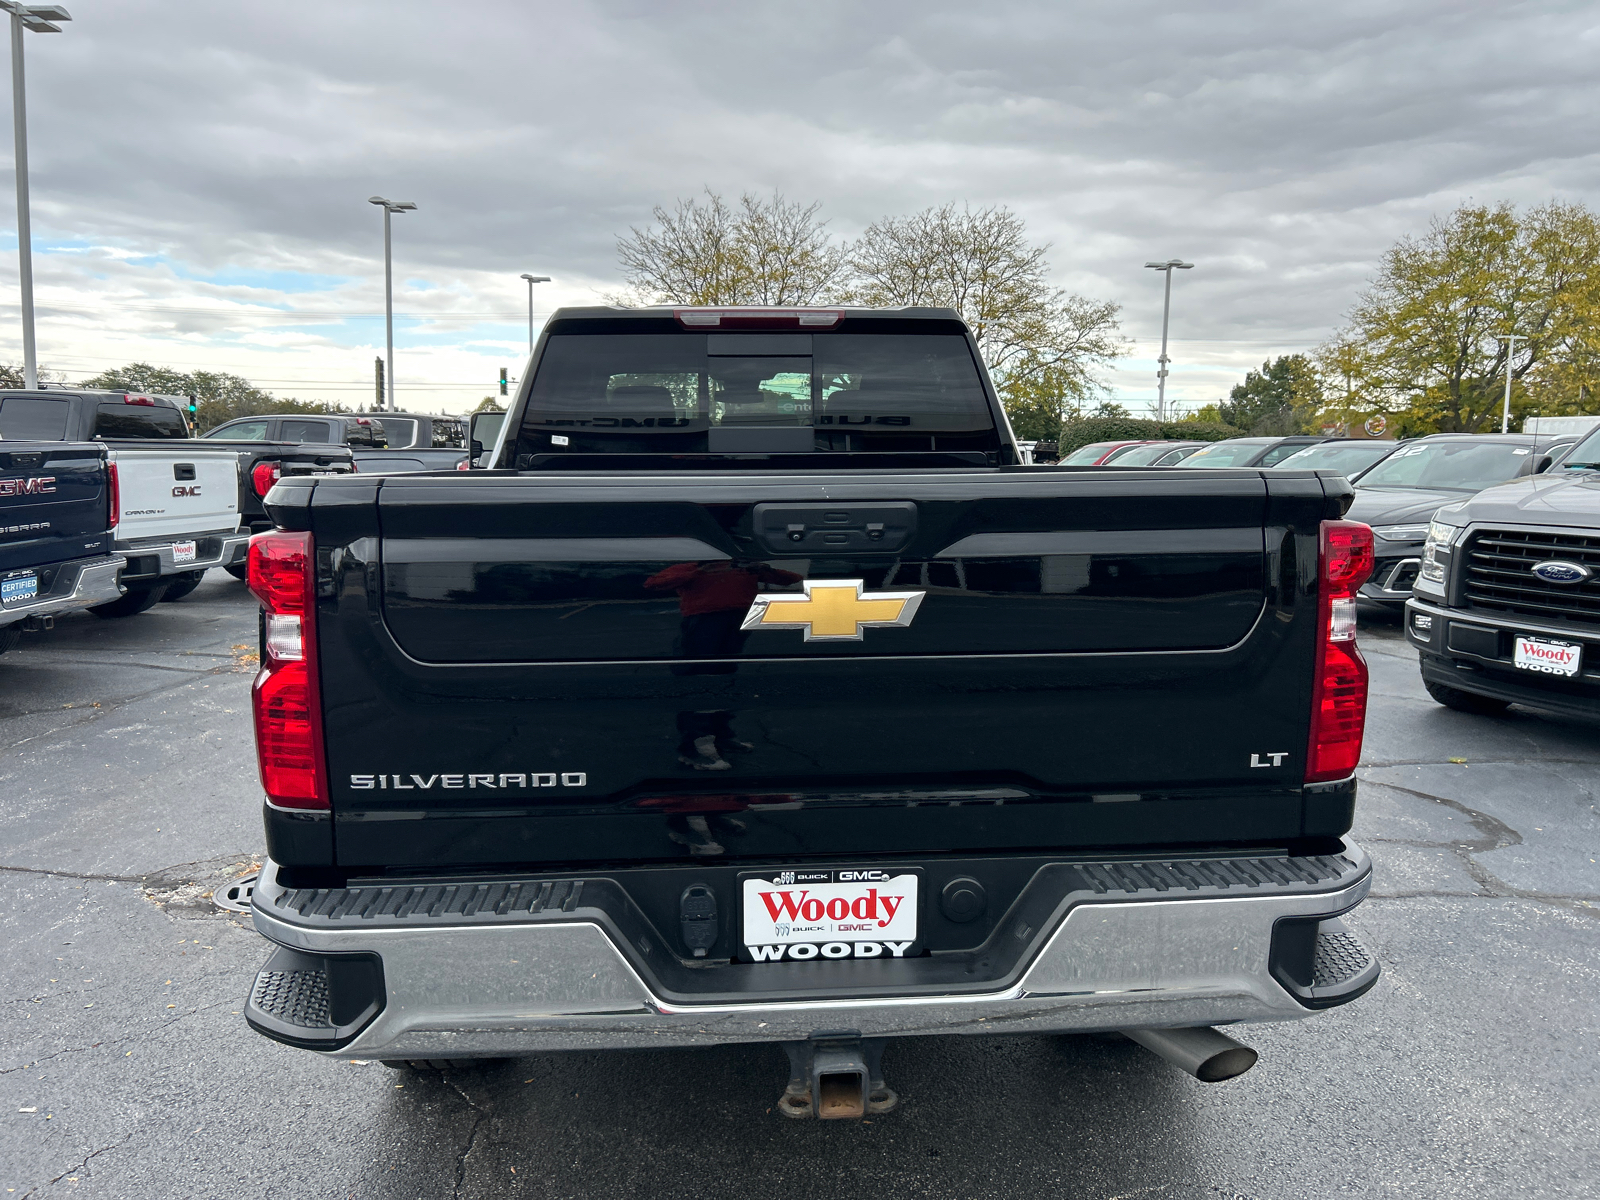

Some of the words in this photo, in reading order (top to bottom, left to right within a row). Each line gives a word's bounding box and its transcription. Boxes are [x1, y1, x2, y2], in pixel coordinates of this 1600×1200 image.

[0, 477, 56, 496] GMC
[172, 486, 201, 497] GMC
[1545, 566, 1574, 579] Ford
[1, 579, 37, 593] CERTIFIED
[2, 591, 38, 604] WOODY
[1522, 643, 1575, 665] Woody
[1514, 661, 1574, 677] WOODY
[1250, 752, 1289, 767] LT
[350, 772, 587, 789] SILVERADO
[839, 871, 883, 881] GMC
[758, 888, 905, 928] Woody
[837, 923, 873, 932] GMC
[748, 941, 913, 962] WOODY
